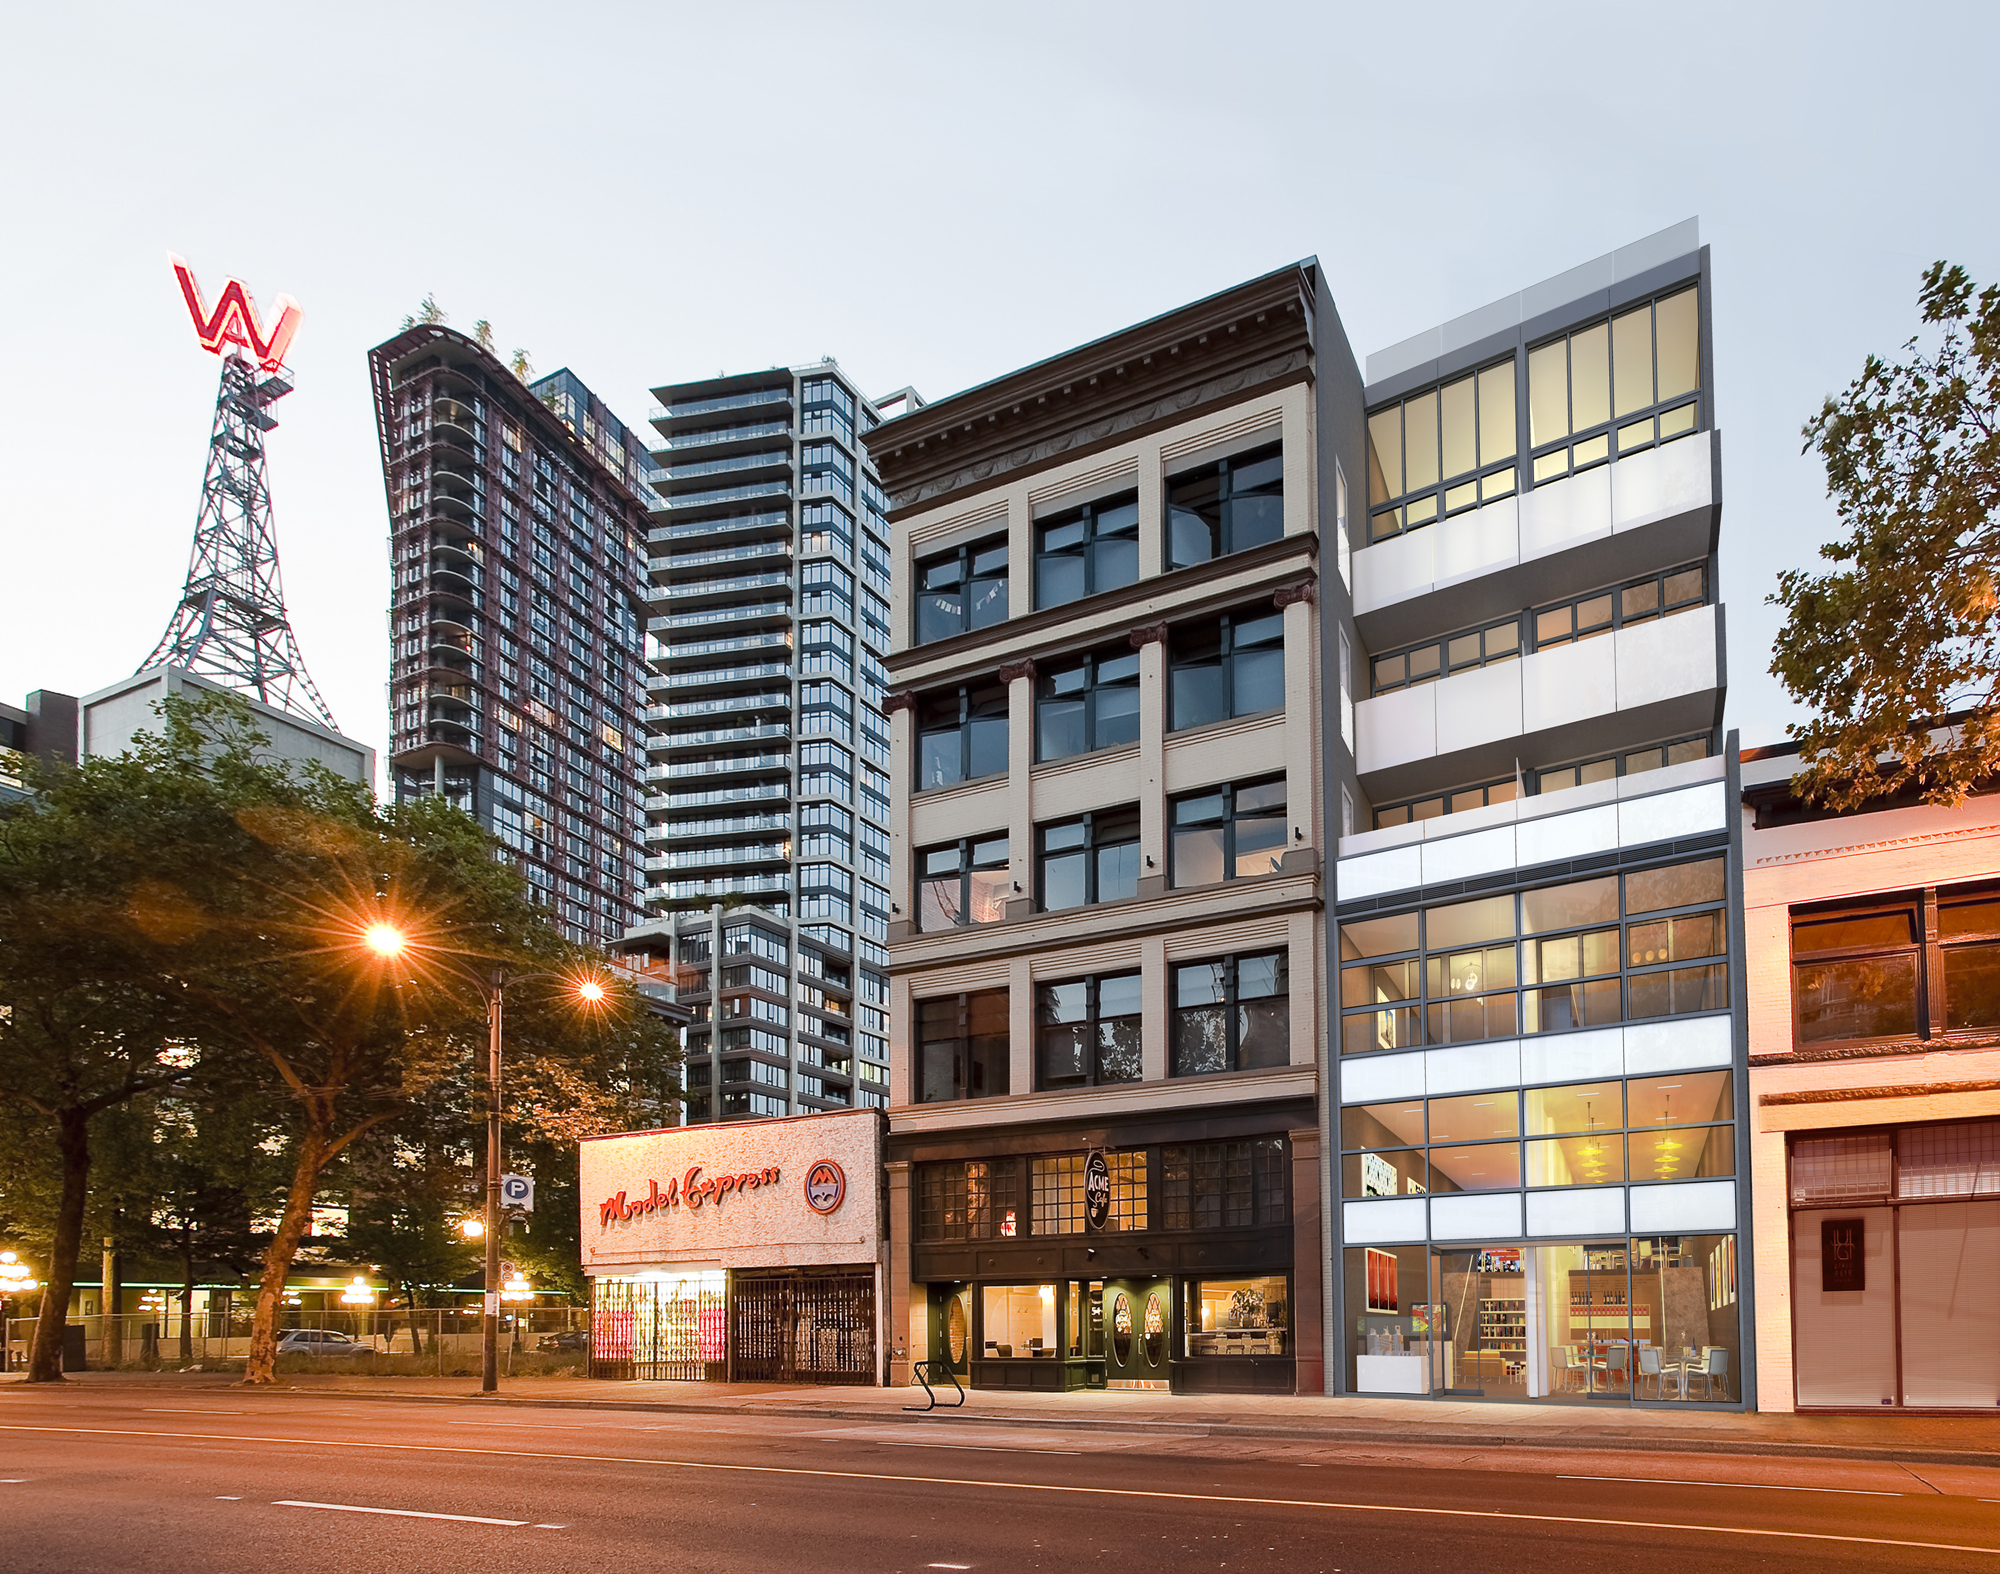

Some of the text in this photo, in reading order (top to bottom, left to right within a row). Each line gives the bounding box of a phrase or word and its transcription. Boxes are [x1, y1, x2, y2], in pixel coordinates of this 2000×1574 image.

[167, 250, 304, 372] W
[511, 1181, 525, 1197] P
[600, 1166, 781, 1226] Model Express
[1088, 1171, 1109, 1192] ACME
